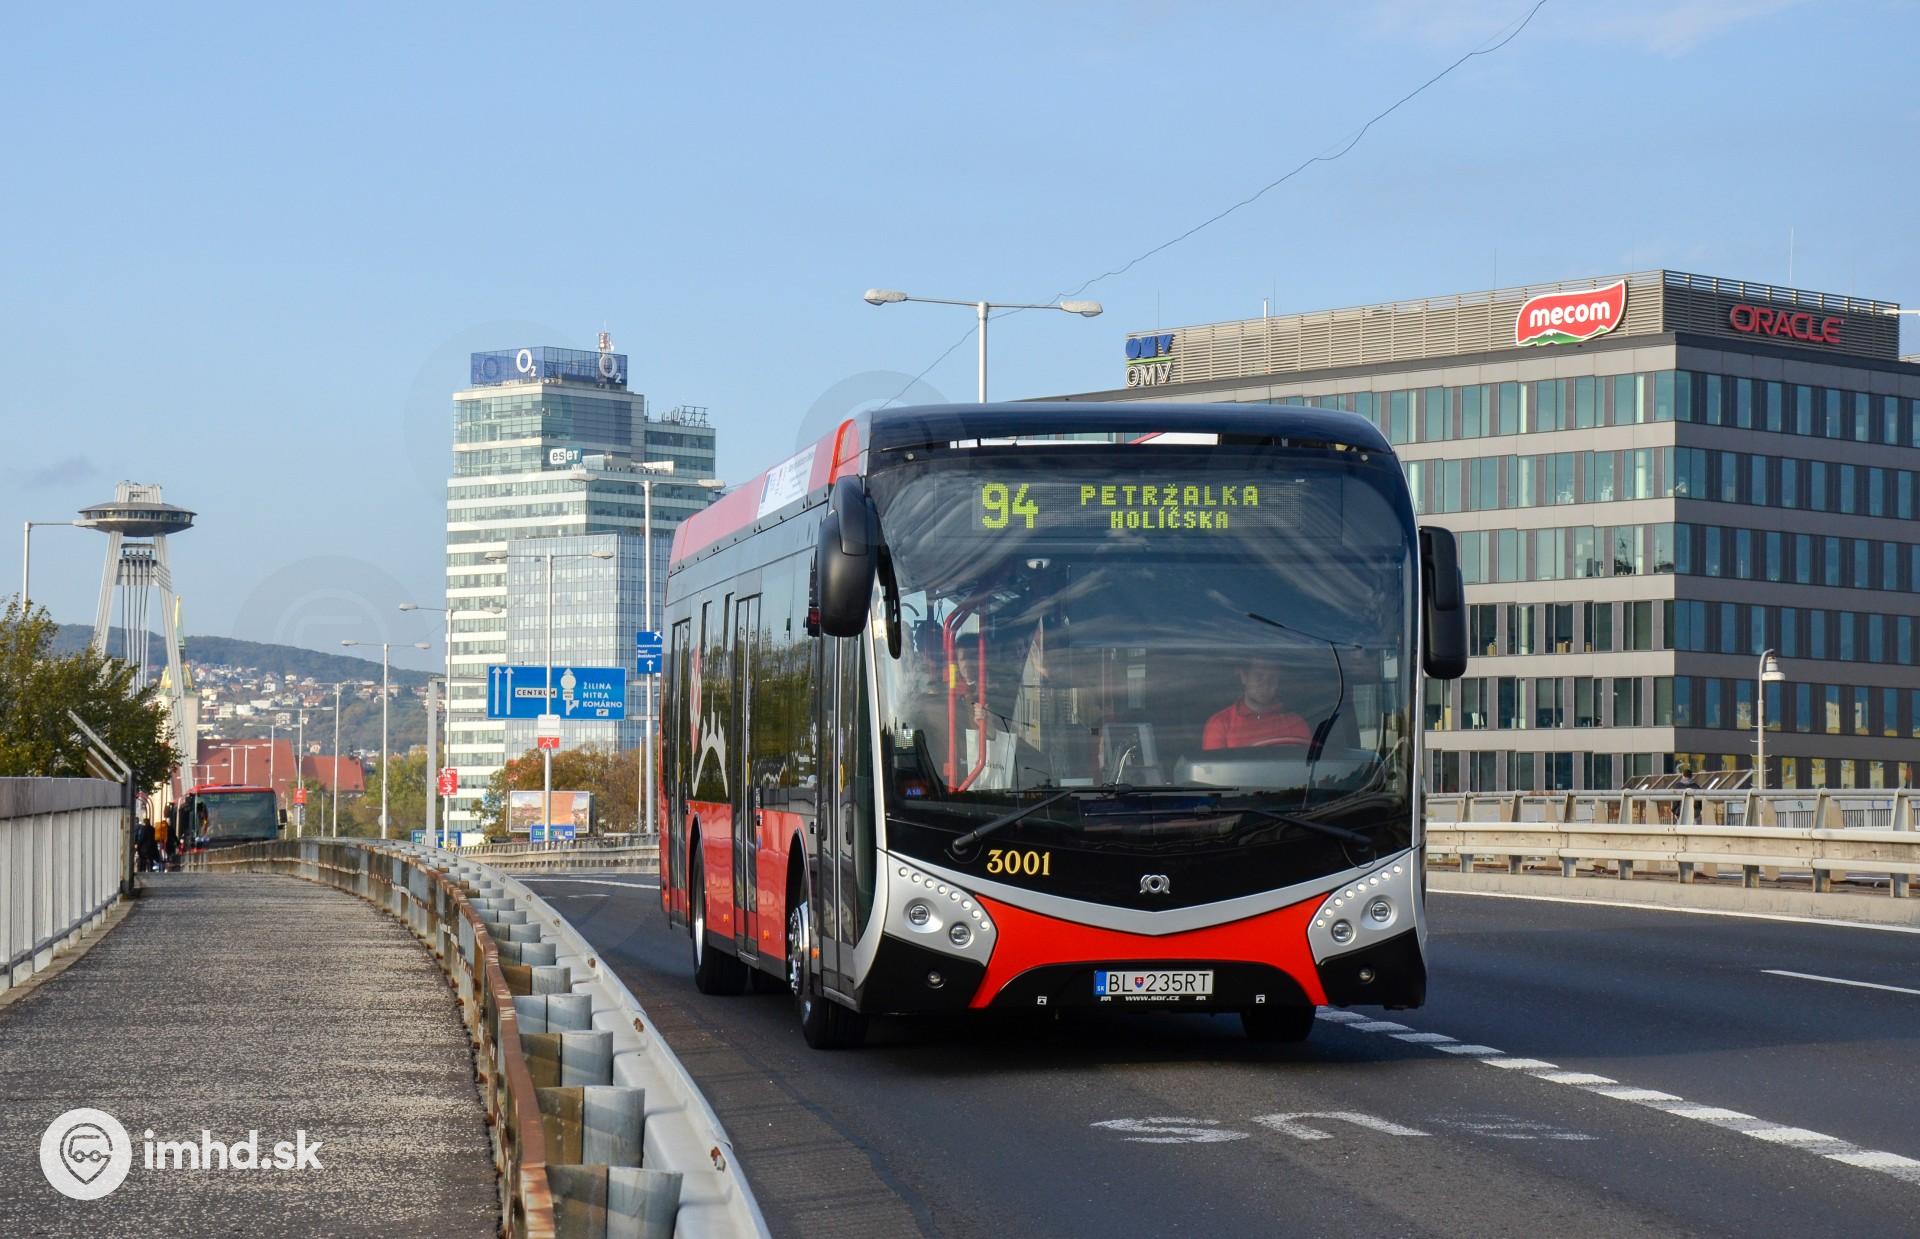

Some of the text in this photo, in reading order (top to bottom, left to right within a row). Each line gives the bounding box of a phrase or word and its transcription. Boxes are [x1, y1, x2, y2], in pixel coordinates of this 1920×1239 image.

[1530, 301, 1610, 328] mecom
[1729, 303, 1841, 343] ORACLE
[1126, 362, 1172, 387] OMV
[981, 483, 1039, 529] 94
[1081, 483, 1259, 506] PETRŽALKA
[1110, 506, 1229, 529] HOLÍČSKA
[582, 691, 609, 699] NITRA
[583, 681, 612, 690] ŽILINA
[582, 699, 623, 708] KOMÁRNO
[986, 849, 1050, 876] 3001
[1108, 973, 1210, 992] BL 235RT
